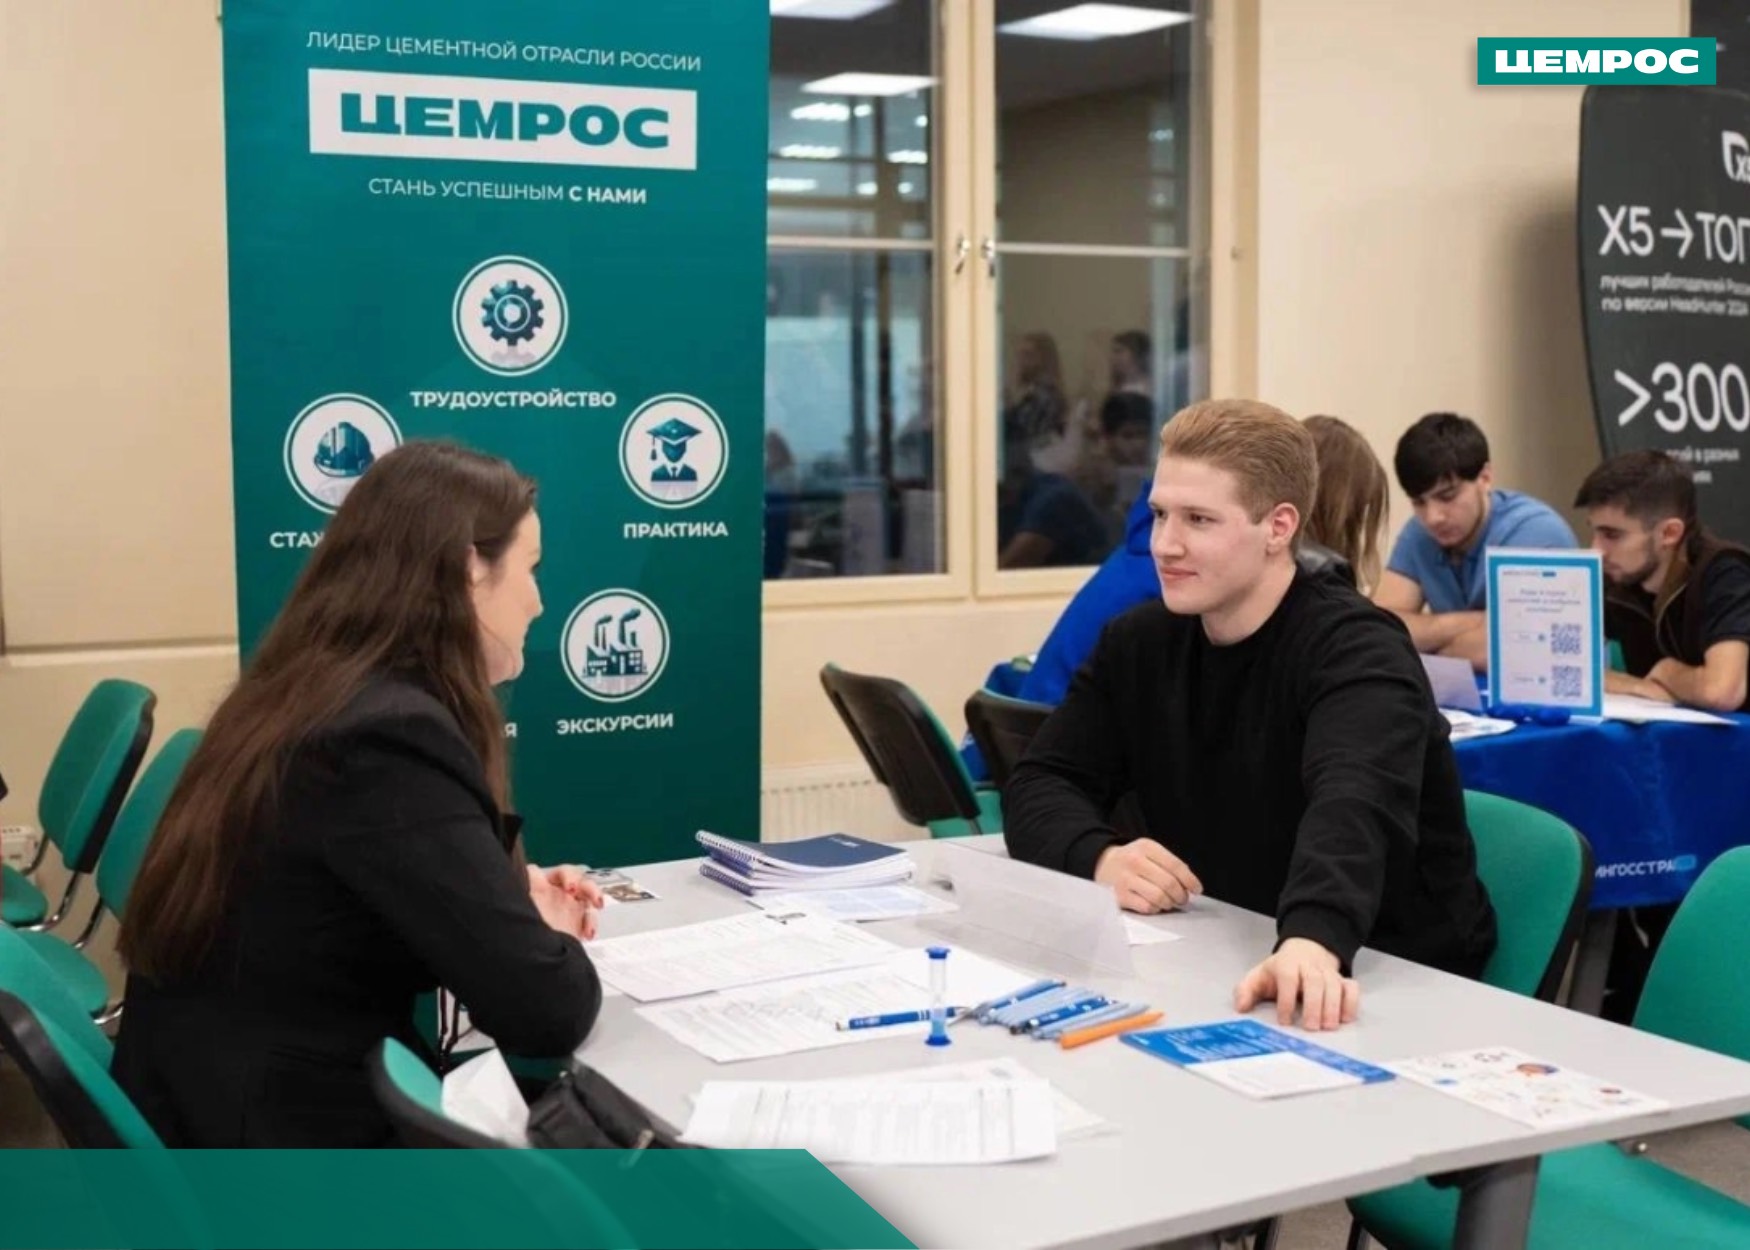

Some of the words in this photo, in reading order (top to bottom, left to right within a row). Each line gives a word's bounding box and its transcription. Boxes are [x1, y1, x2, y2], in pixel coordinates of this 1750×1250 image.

[306, 31, 380, 52] ЛИДЕР
[386, 36, 517, 60] ЦЕМЕНТНОЙ
[522, 45, 615, 66] ОТРАСЛИ
[620, 53, 701, 71] РОССИИ
[340, 92, 670, 149] ЦЕМРОС
[368, 178, 436, 196] СТАНЬ
[440, 181, 564, 201] УСПЕШНЫМ
[568, 186, 583, 202] С
[587, 187, 647, 204] НАМИ
[410, 388, 617, 410] ТРУДОУСТРОЙСТВО
[1614, 361, 1750, 433] >300
[623, 520, 729, 538] ПРАКТИКА
[556, 713, 674, 736] ЭКСКУРСИИ
